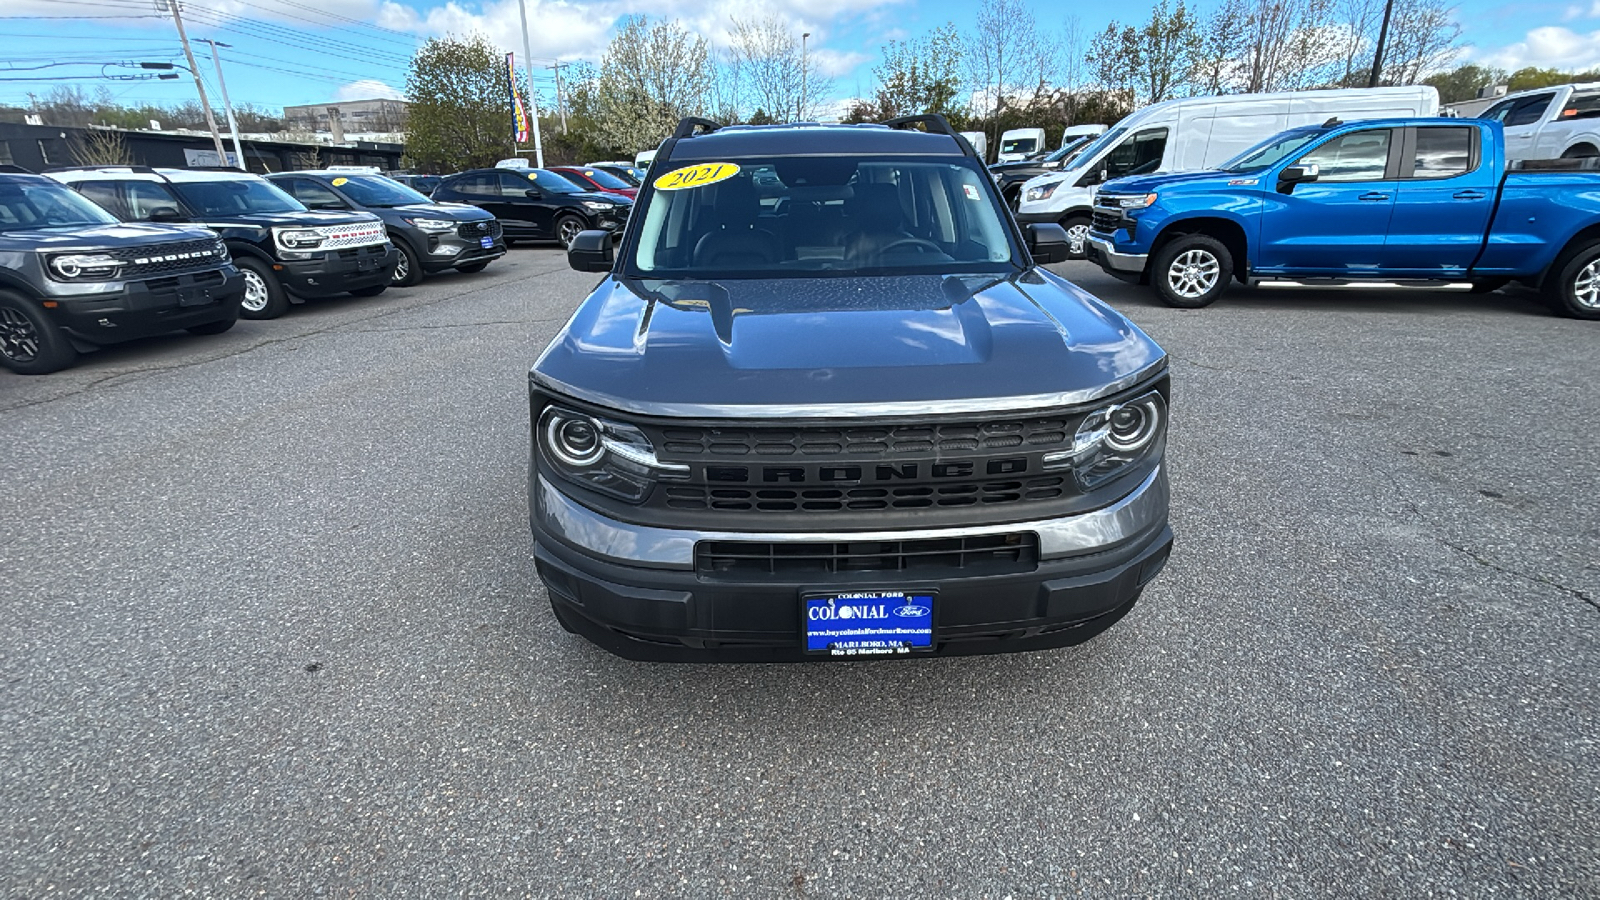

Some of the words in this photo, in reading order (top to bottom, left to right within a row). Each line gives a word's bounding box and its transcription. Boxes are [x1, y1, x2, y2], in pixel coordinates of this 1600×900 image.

[667, 165, 724, 187] 2021
[332, 230, 379, 239] BRONCO
[135, 248, 212, 265] BRONCO
[707, 457, 1028, 482] BRONCO
[808, 604, 889, 621] COLONIAL
[831, 648, 845, 656] Rte
[858, 646, 893, 655] Marlboro
[897, 646, 911, 654] MA
[888, 640, 904, 648] MA
